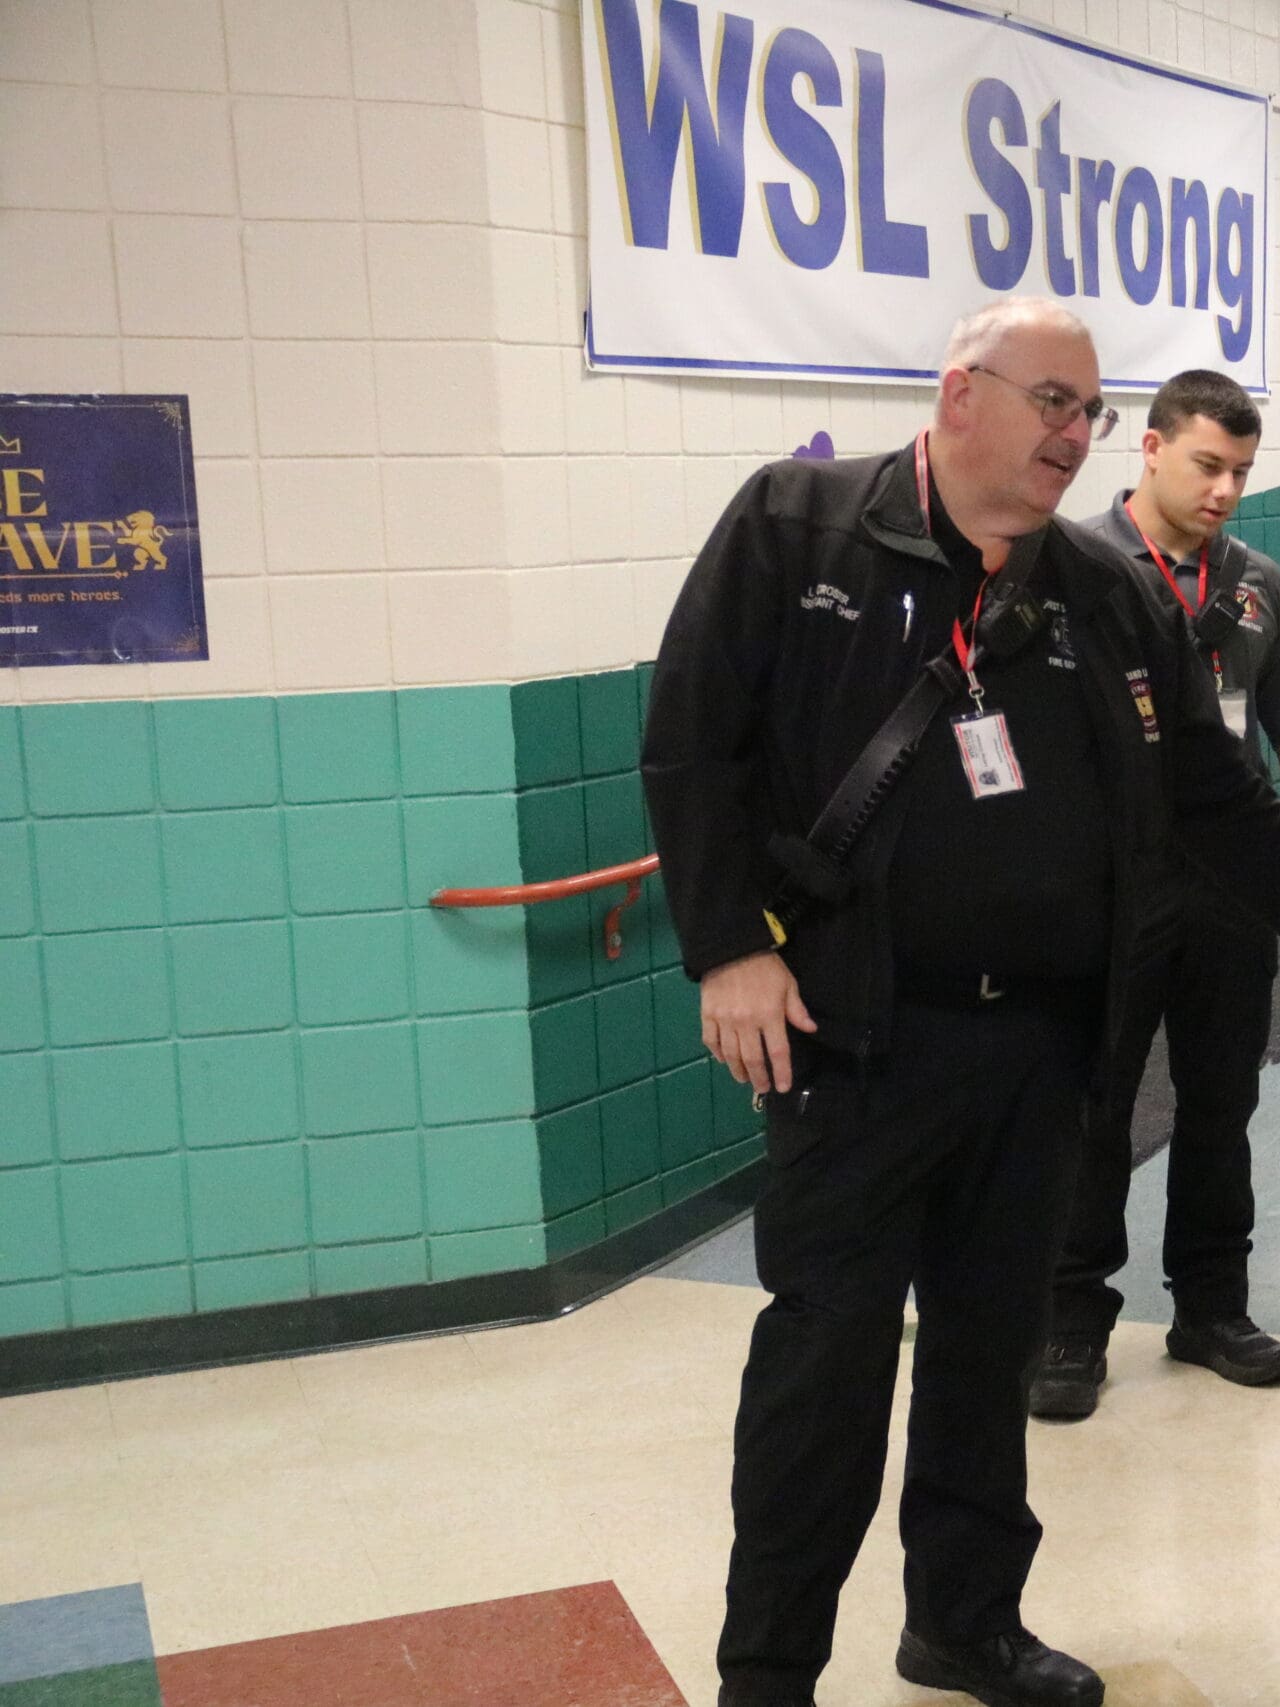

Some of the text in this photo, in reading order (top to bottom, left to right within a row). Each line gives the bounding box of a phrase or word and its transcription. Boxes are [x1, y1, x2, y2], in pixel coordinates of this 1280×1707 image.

[600, 0, 1254, 363] WSL Strong
[0, 521, 117, 570] AVE
[28, 592, 65, 602] more
[70, 590, 124, 601] heroes.
[837, 604, 861, 620] CHIEF
